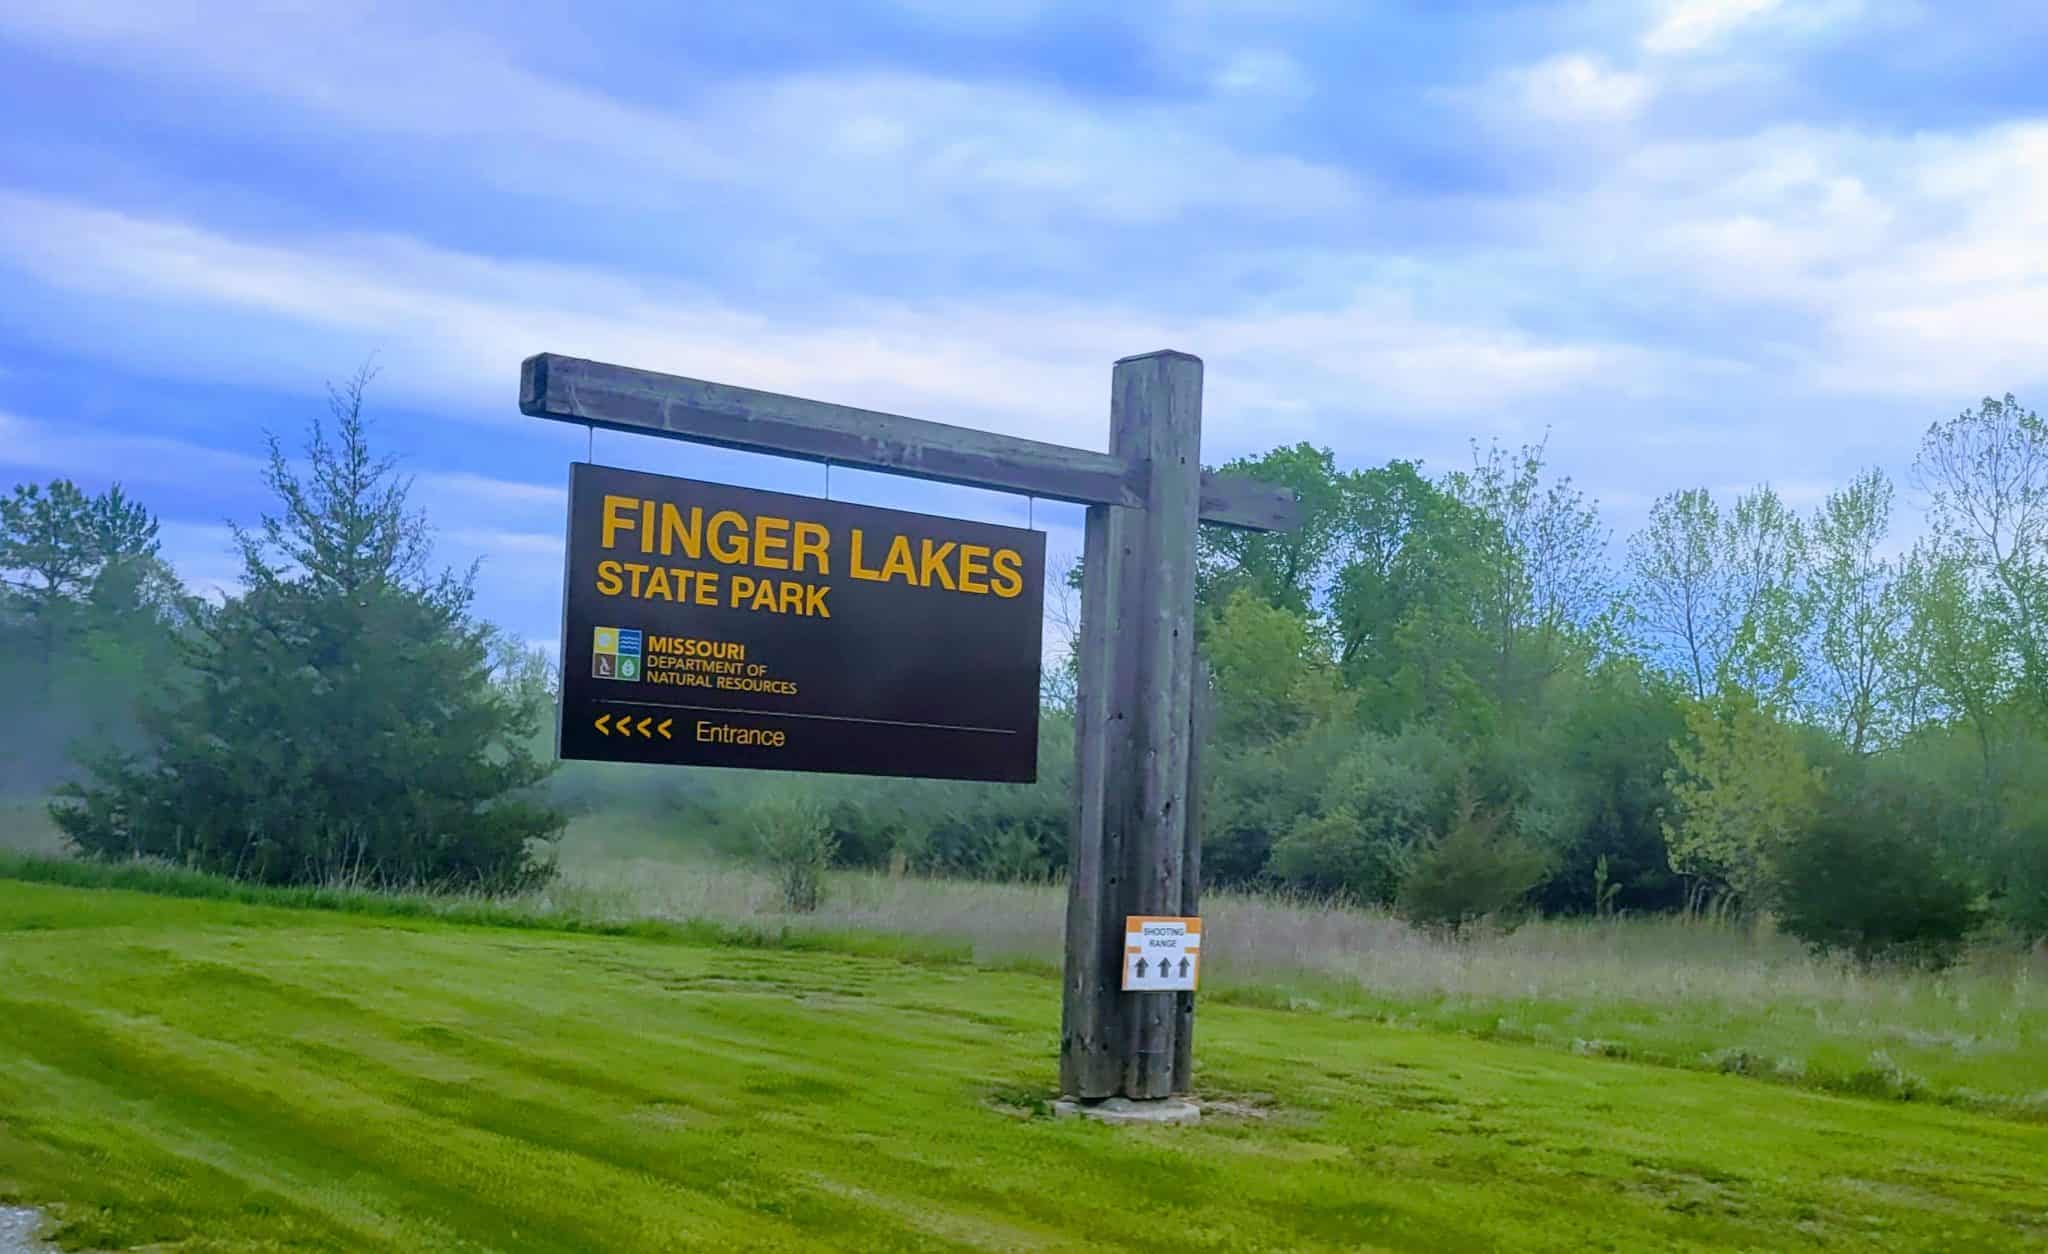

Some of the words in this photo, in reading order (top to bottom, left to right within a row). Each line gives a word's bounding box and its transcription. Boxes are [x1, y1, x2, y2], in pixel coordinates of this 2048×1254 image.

[601, 495, 831, 575] FINGER
[849, 528, 1024, 599] LAKES
[596, 560, 719, 607] STATE
[730, 575, 831, 619] PARK
[648, 635, 745, 660] MISSOURI
[647, 655, 744, 676] DEPARTMENT
[746, 664, 768, 677] OF
[646, 671, 713, 688] NATURAL
[716, 678, 798, 695] RESOURCES
[696, 721, 786, 747] Entrance
[1144, 928, 1185, 936] SHOOTING
[1149, 940, 1177, 948] RANGE
